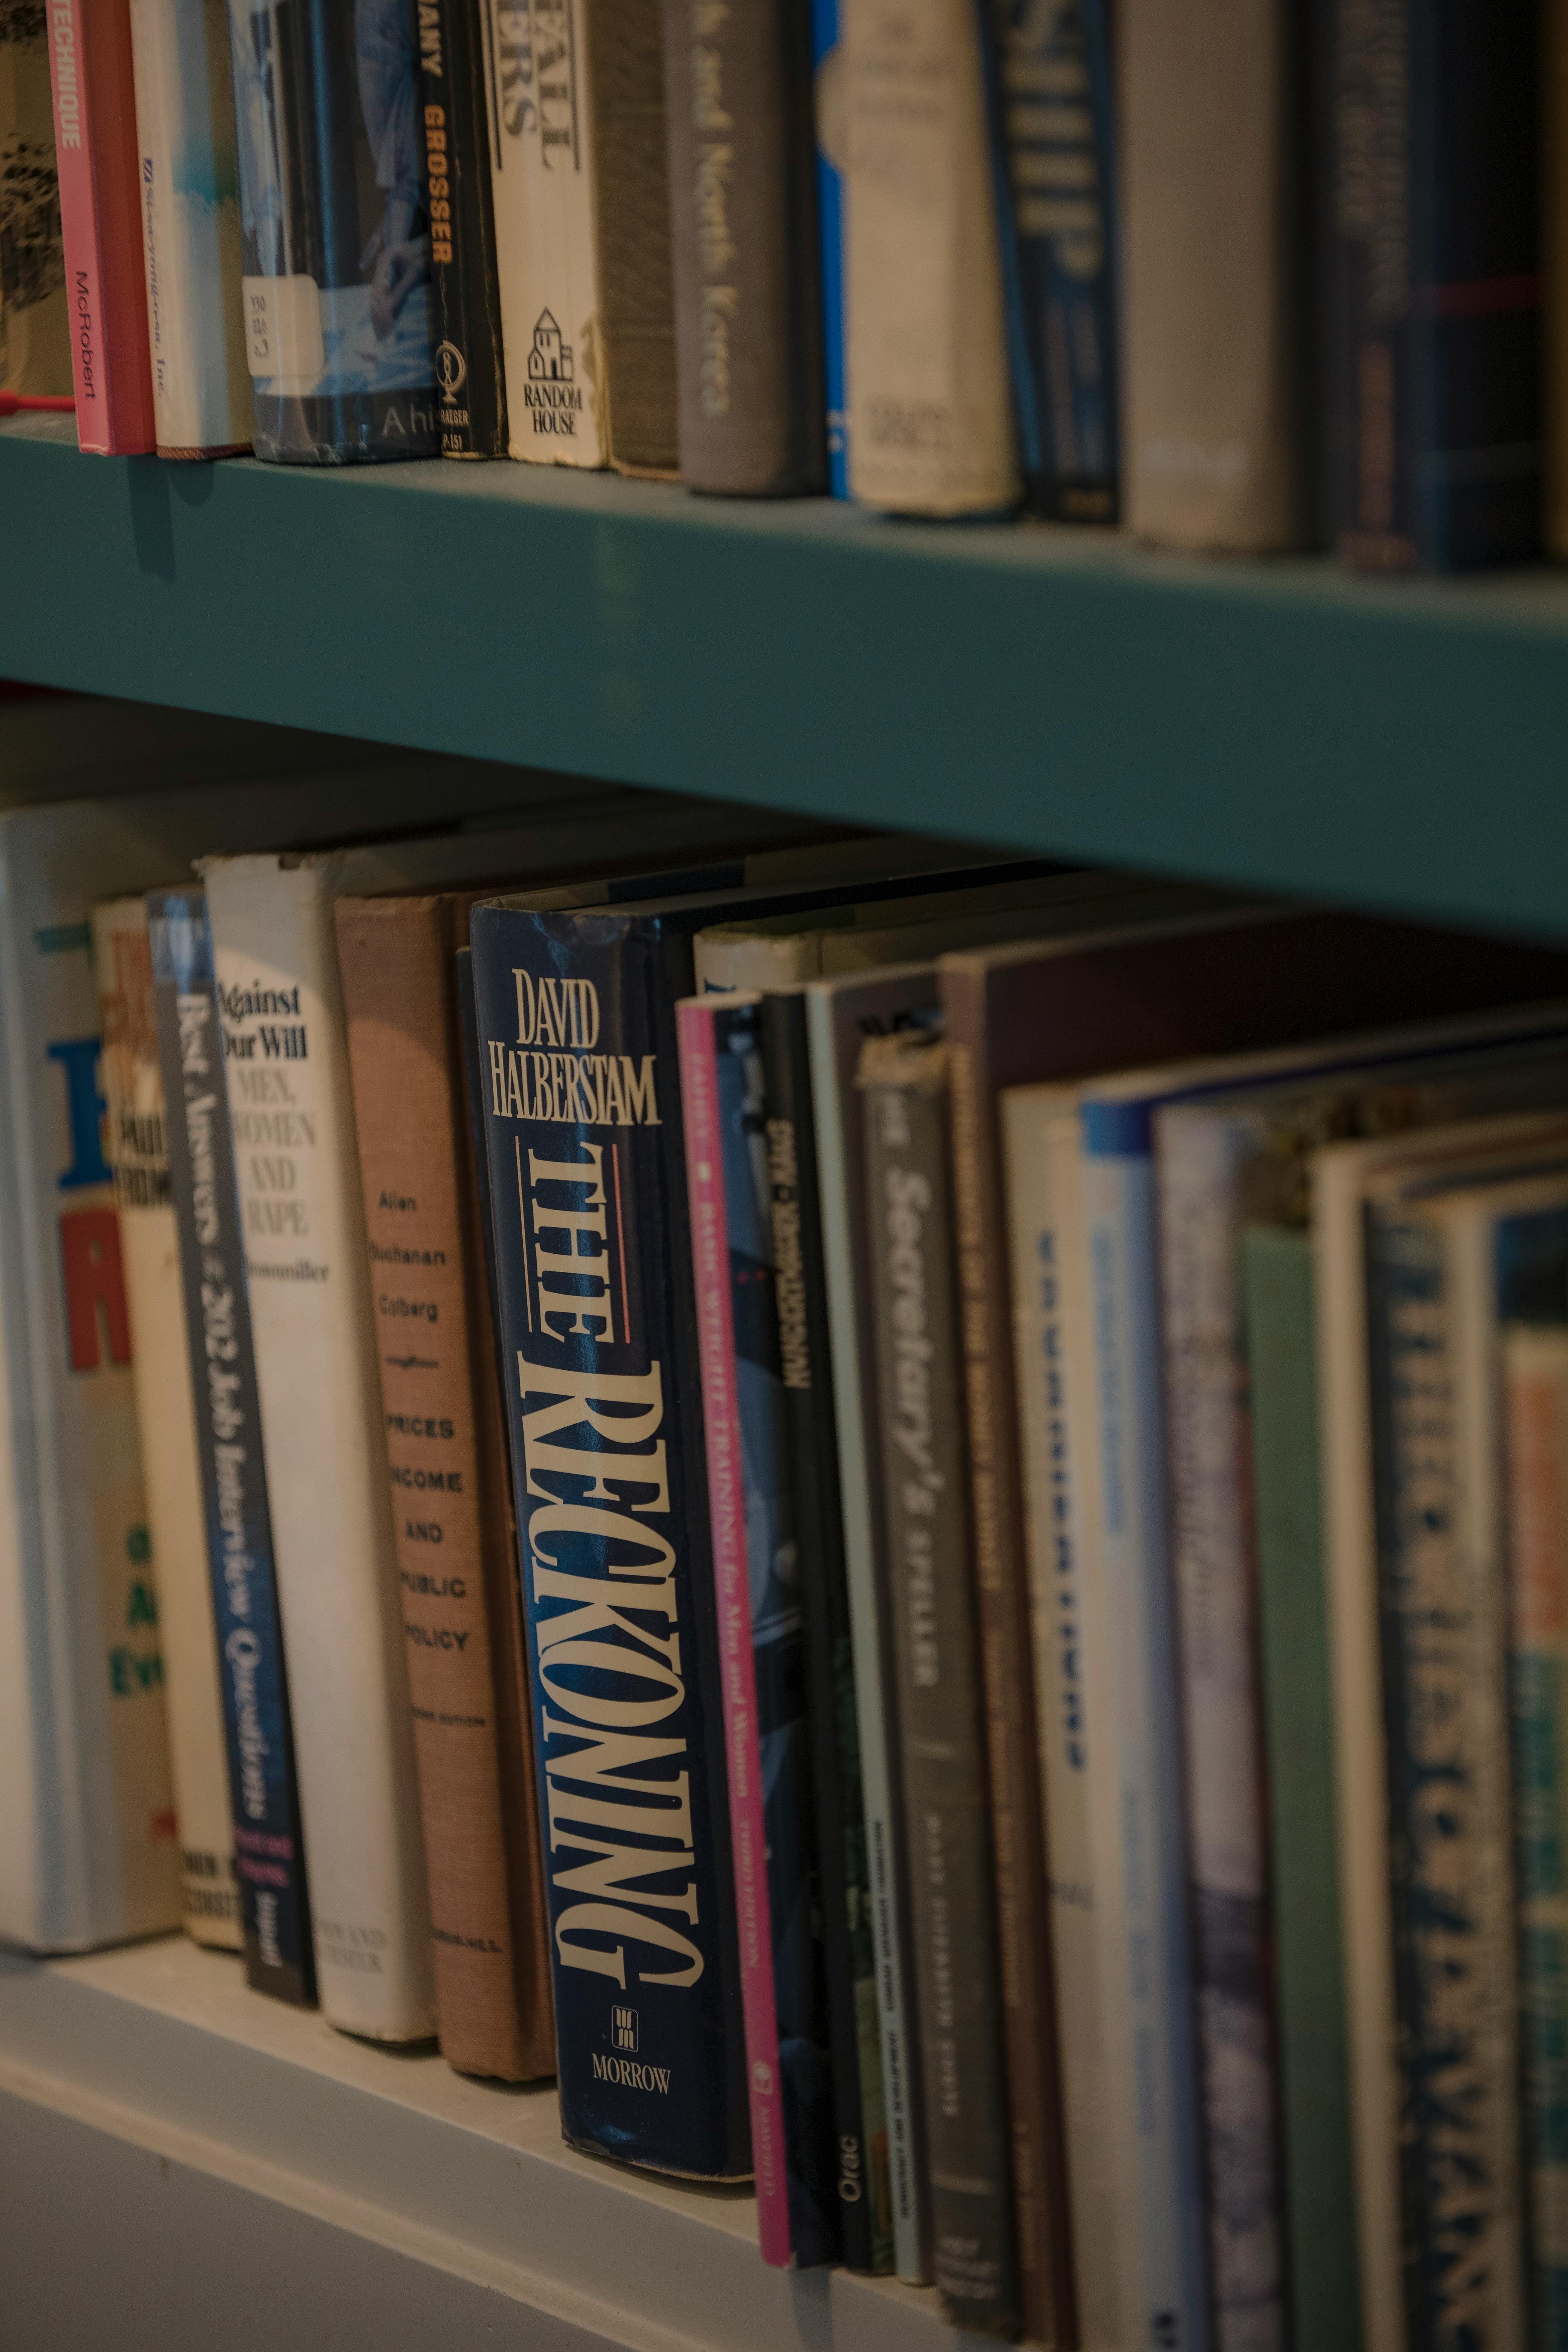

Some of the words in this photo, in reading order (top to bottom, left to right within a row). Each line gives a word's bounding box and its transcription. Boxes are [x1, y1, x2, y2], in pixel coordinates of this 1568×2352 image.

[417, 0, 444, 78] ANY
[423, 103, 453, 265] GROSSER
[694, 142, 737, 274] North
[76, 271, 95, 400] McRobert
[699, 285, 738, 416] Korea
[410, 403, 433, 433] hi
[440, 408, 470, 427] RAEGER
[524, 384, 582, 410] RANDOM
[532, 410, 576, 436] HOUSE
[176, 992, 211, 1075] Best
[257, 1024, 308, 1060] Will
[512, 967, 600, 1049] DAVID
[488, 1041, 663, 1126] HALBERSTAM
[880, 1092, 910, 1147] HE
[184, 1079, 221, 1244] Answers
[378, 1190, 416, 1211] Allen
[369, 1244, 446, 1265] Buchanan
[528, 1142, 615, 1344] THE
[698, 1202, 719, 1272] BASIC
[704, 1287, 728, 1403] WEIGHT
[885, 1168, 945, 1518] Secretary's
[207, 1358, 244, 1440] Job
[386, 1415, 454, 1438] PRICES
[390, 1465, 462, 1492] NCOME
[712, 1419, 743, 1557] TRAINING
[214, 1444, 256, 1620] Interview
[406, 1521, 443, 1543] AND
[400, 1571, 466, 1598] PUBLIC
[725, 1559, 741, 1594] for
[906, 1530, 940, 1688] SPELLER
[405, 1625, 469, 1652] POLICY
[727, 1599, 743, 1654] Men
[517, 1349, 704, 1991] RECKONING
[729, 1660, 746, 1704] and
[224, 1627, 271, 1820] Questions
[733, 1711, 750, 1798] Women
[744, 1883, 759, 1968] EDITION
[591, 2053, 671, 2095] MORROW
[837, 2135, 862, 2202] Orac
